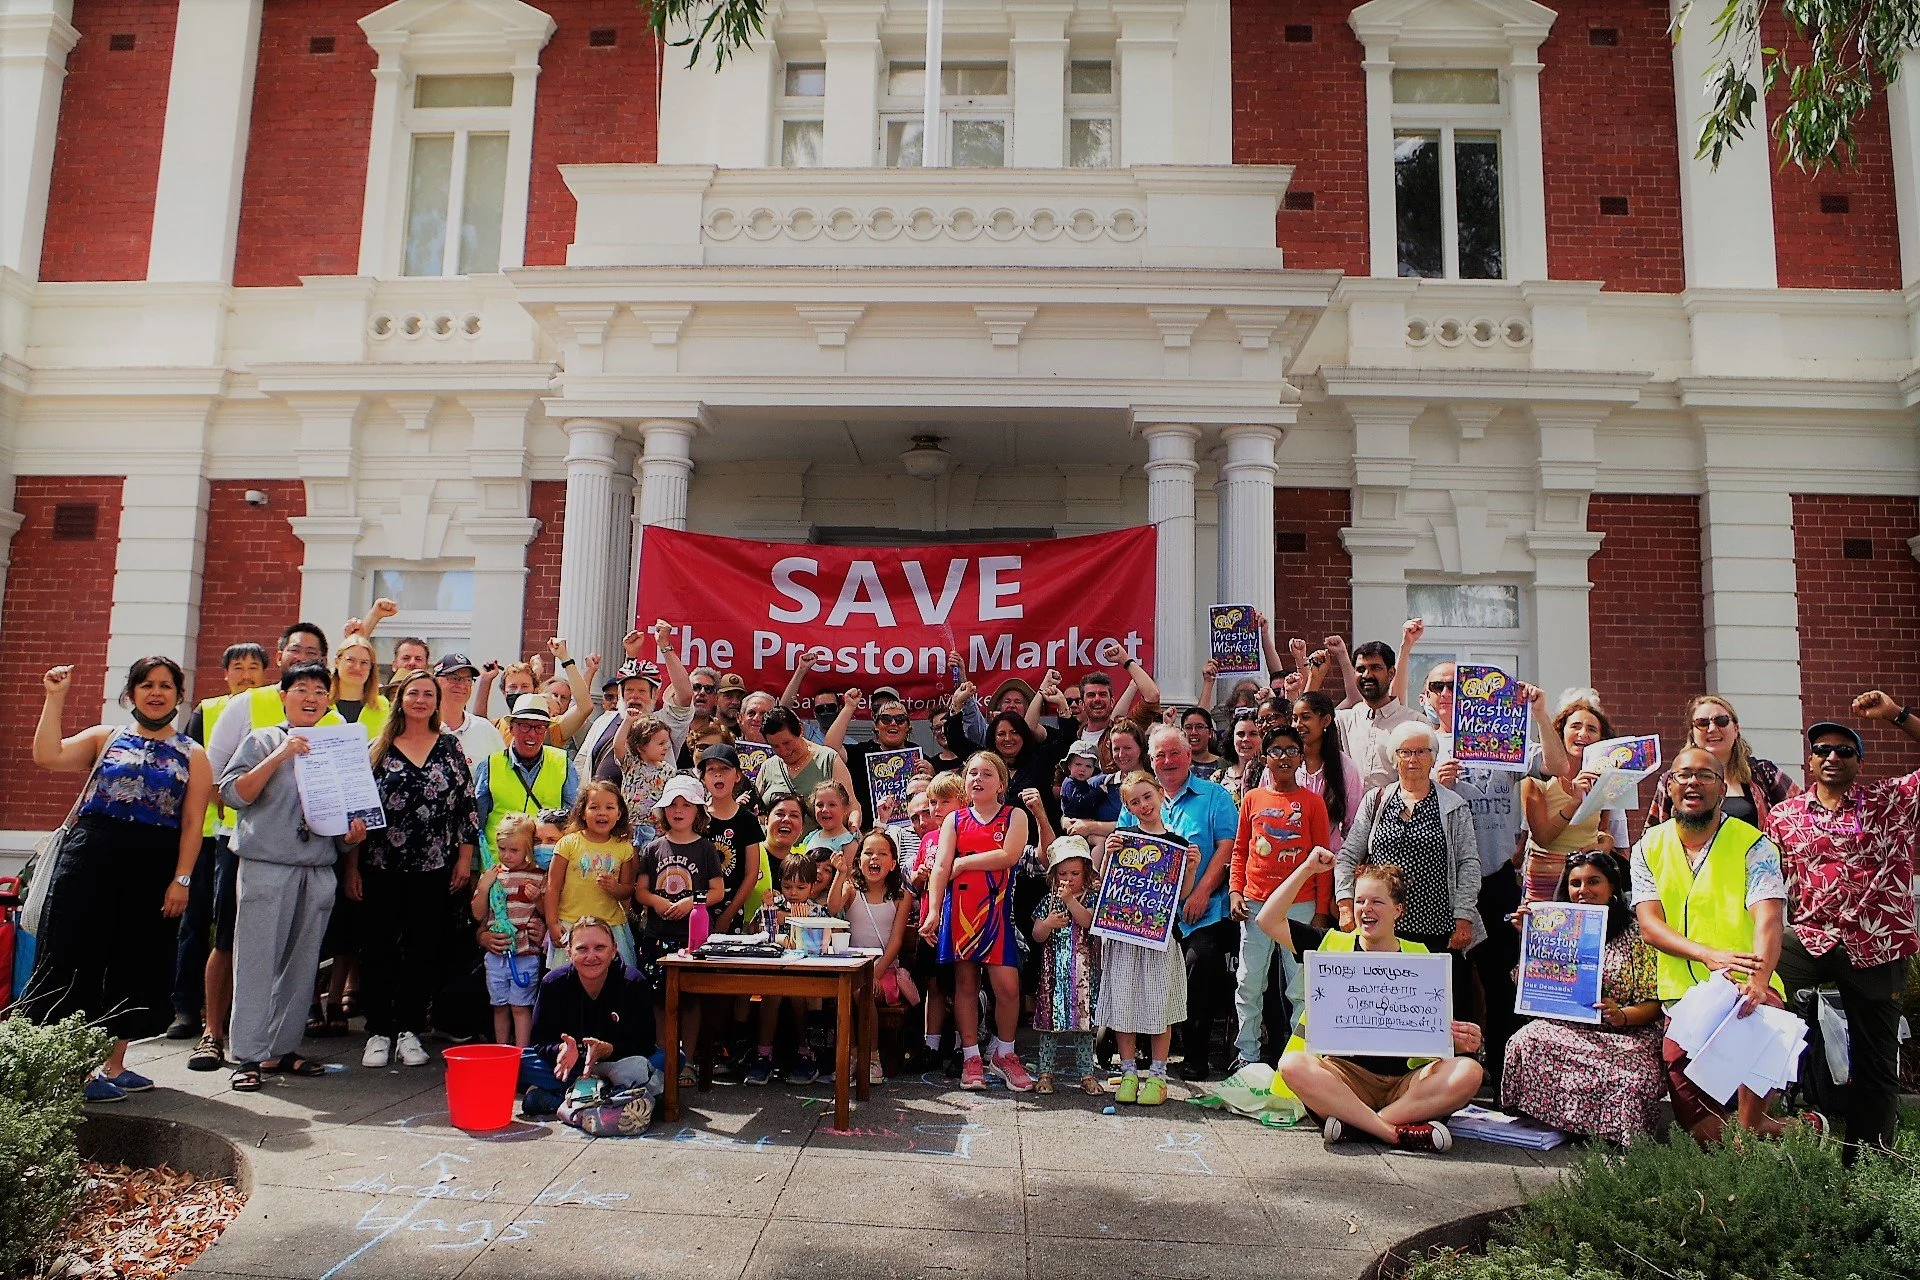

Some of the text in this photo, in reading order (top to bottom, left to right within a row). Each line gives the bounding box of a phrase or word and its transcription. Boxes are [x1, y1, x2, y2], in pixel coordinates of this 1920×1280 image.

[768, 555, 1024, 628] SAVE
[647, 625, 1143, 675] The Preston Market
[1466, 676, 1502, 695] SAVE
[655, 855, 689, 874] SEEKER
[1121, 849, 1158, 866] SAVE
